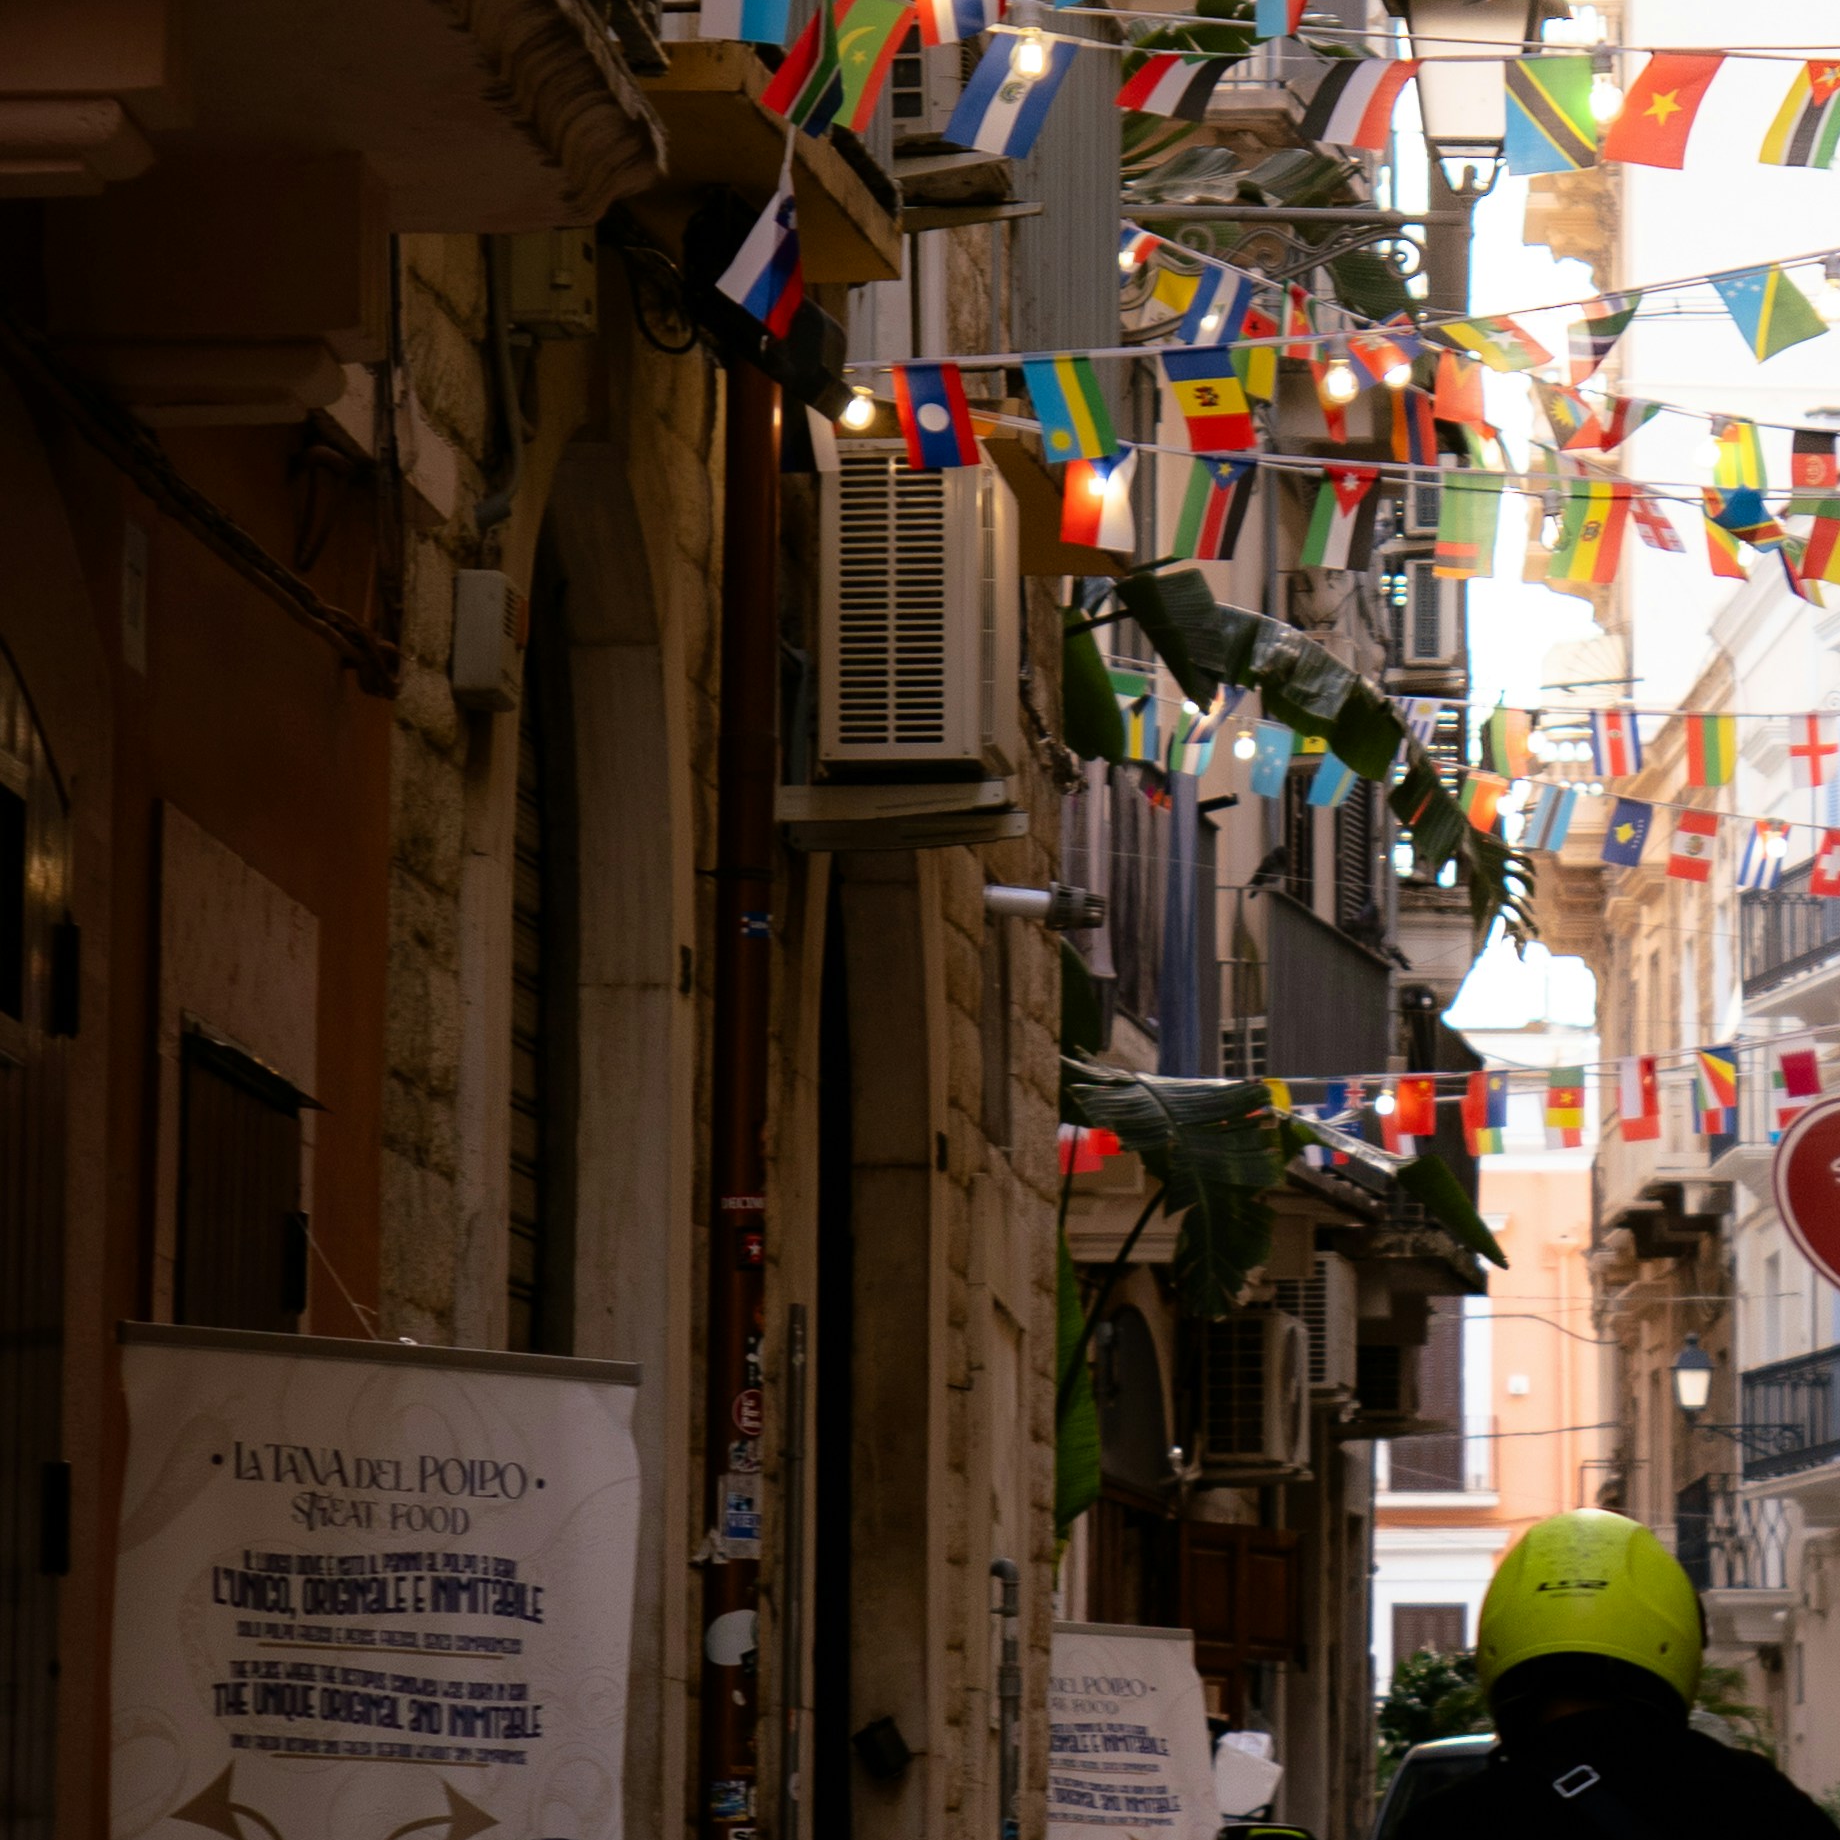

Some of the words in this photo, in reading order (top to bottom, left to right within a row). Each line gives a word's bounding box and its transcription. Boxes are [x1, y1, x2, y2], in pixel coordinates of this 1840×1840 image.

[235, 1442, 263, 1481] LA
[264, 1443, 349, 1489] TANA
[354, 1457, 414, 1492] DEL
[418, 1454, 528, 1500] POLPO
[389, 1502, 471, 1536] FOOD
[303, 1576, 407, 1615] ORIGINALE
[414, 1576, 425, 1611] E
[431, 1576, 544, 1624] INIMITABILE
[213, 1682, 247, 1716] THE
[253, 1682, 315, 1721] UNIQUE
[320, 1687, 403, 1730] ORIGINAL
[409, 1699, 442, 1735] AND
